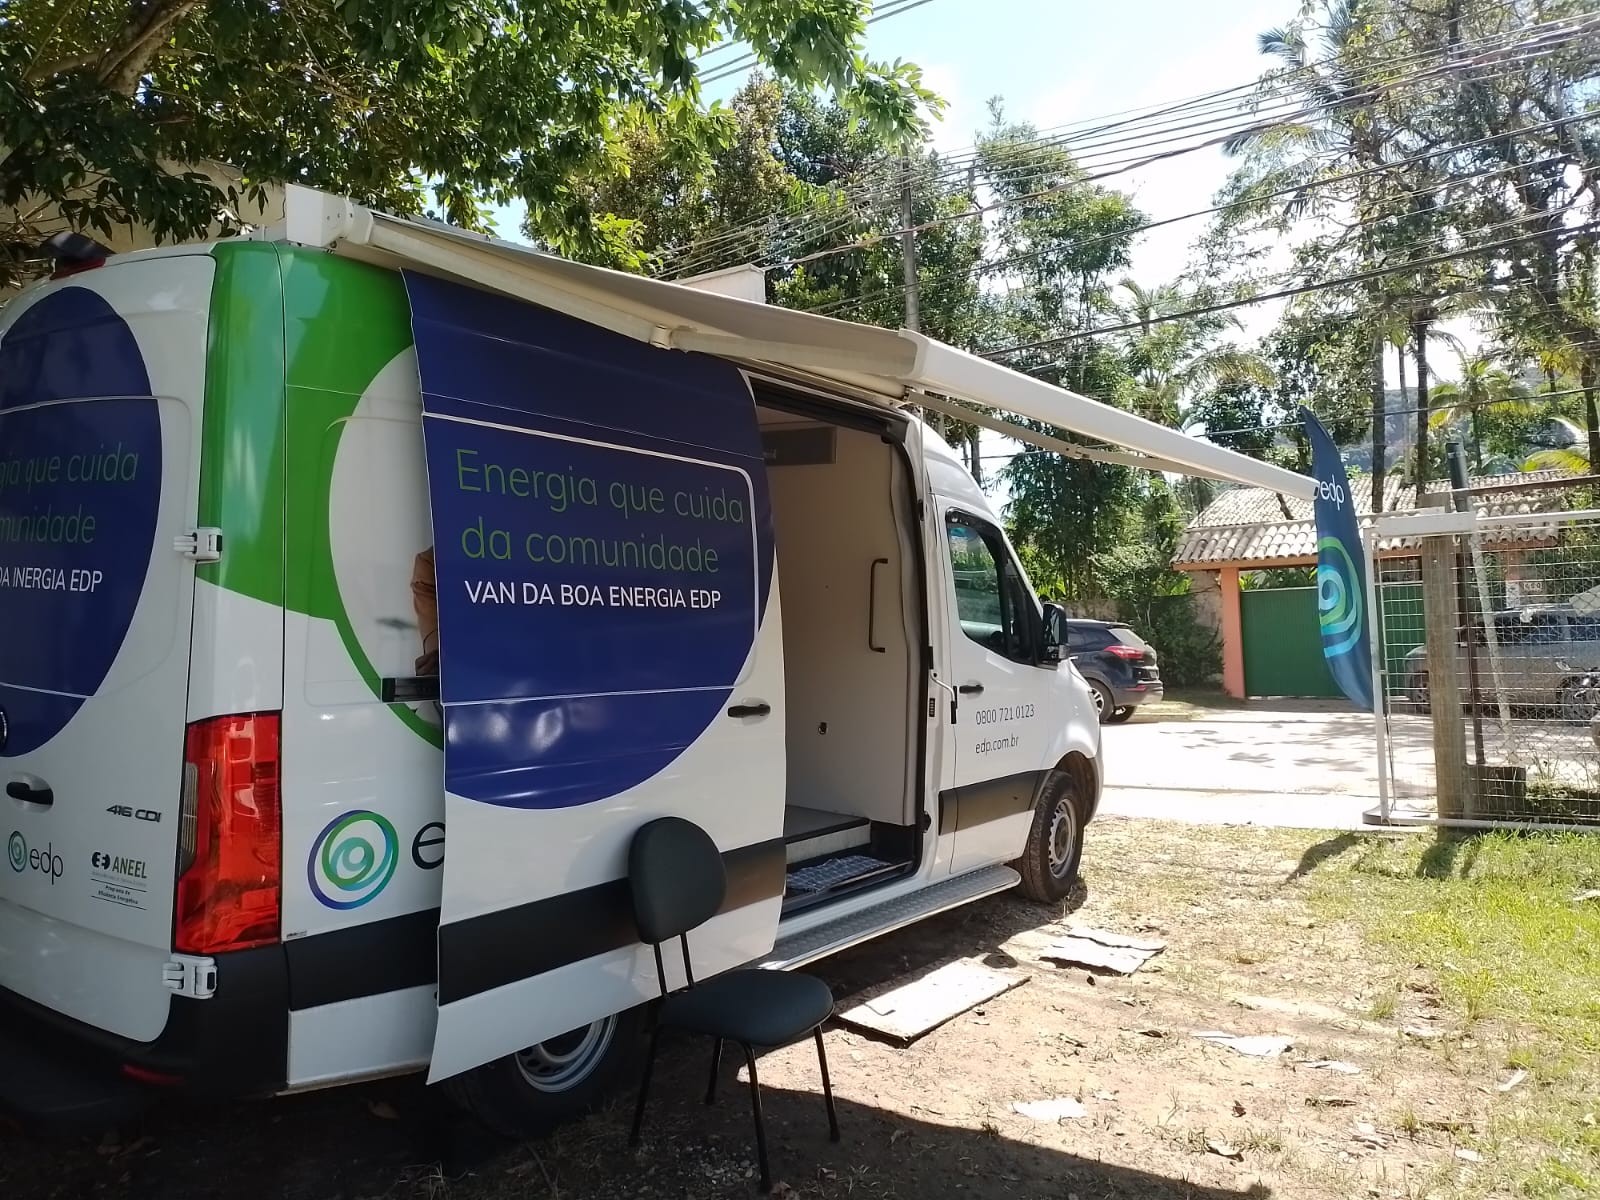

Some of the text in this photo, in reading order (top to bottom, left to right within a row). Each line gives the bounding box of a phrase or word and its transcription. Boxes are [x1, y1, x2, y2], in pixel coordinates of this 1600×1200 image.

[25, 454, 61, 494] que
[67, 441, 139, 482] cuida
[456, 448, 744, 523] Energia que cuida
[1320, 474, 1345, 511] edp
[461, 516, 719, 573] da comunidade
[70, 569, 103, 593] EDP
[464, 580, 721, 609] VAN DA BOA ENERGIA EDP
[975, 703, 1035, 725] 0800 721 0123
[975, 732, 1019, 756] edp.com.br
[106, 804, 162, 823] 416 CDI
[29, 842, 63, 885] edp
[112, 856, 147, 879] ANEEL
